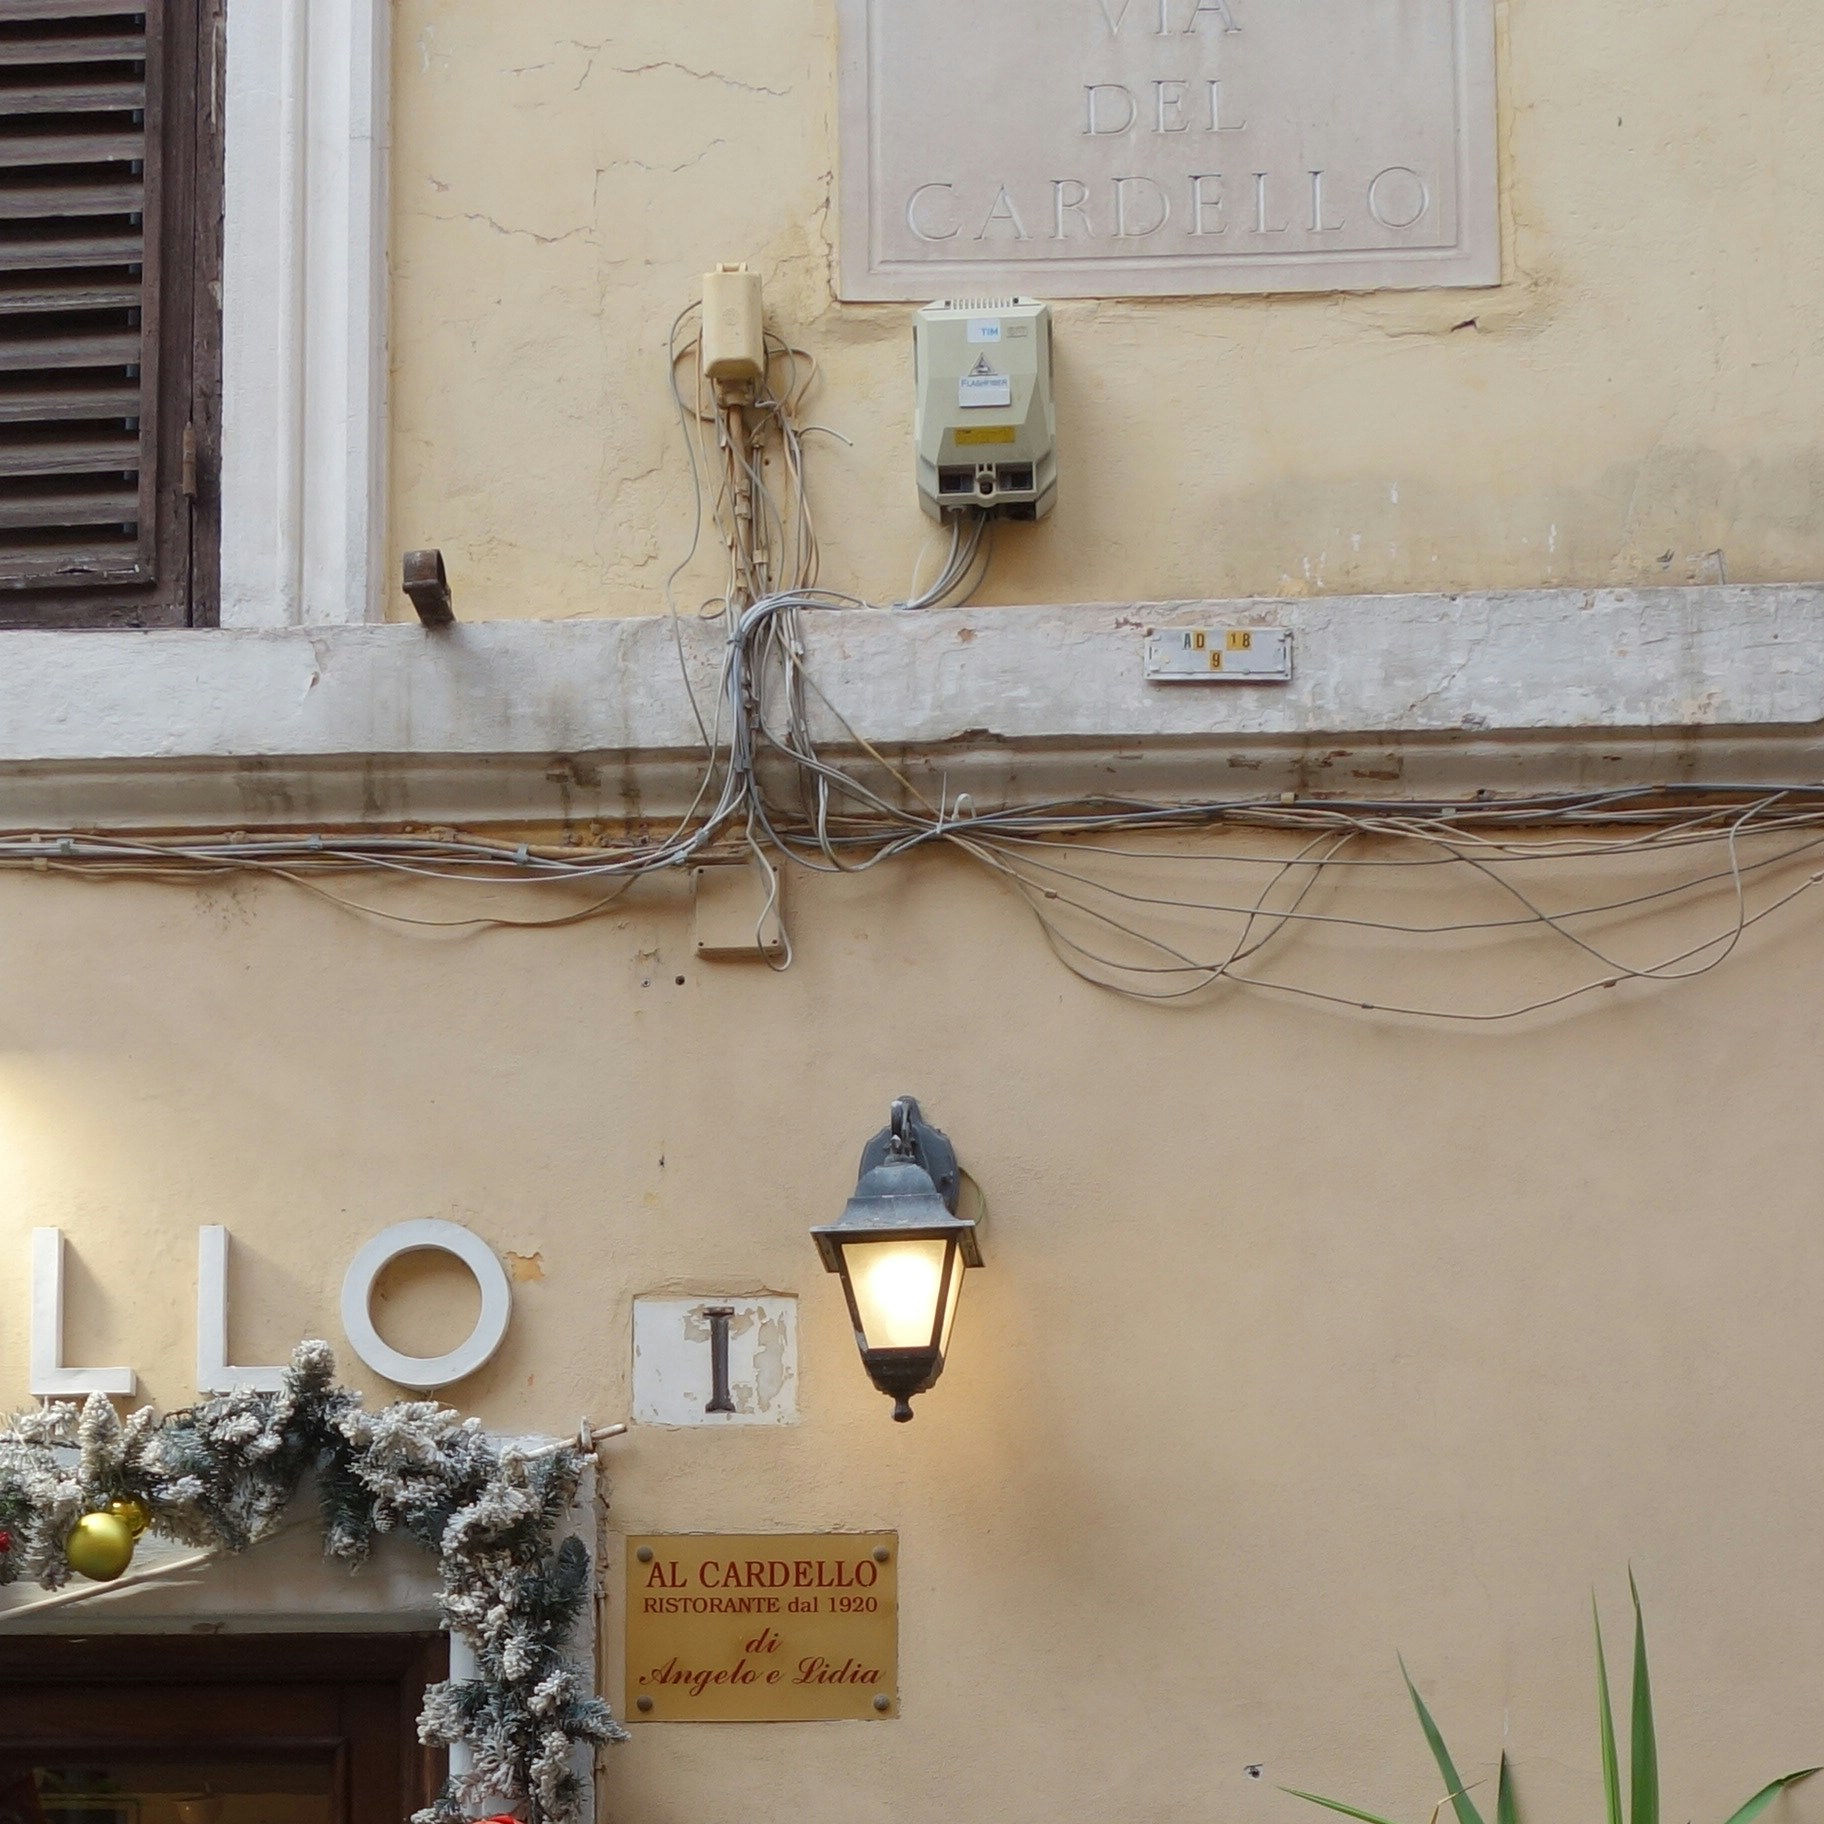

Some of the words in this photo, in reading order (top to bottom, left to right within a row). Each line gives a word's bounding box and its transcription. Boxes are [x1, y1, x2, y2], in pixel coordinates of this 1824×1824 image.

[1097, 0, 1242, 36] VIA
[1082, 80, 1246, 135] DEL
[906, 166, 1430, 242] CARDELLO
[980, 328, 999, 337] TIM
[1183, 632, 1206, 650] AD
[1230, 632, 1251, 649] 18
[1212, 652, 1221, 669] 9
[646, 1560, 688, 1588] AL
[699, 1559, 879, 1588] CARDELLO
[643, 1596, 781, 1614] RISTORANTE
[787, 1595, 819, 1614] dal
[828, 1596, 879, 1614] 1920
[744, 1627, 783, 1655] di
[639, 1656, 762, 1697] Angelo
[766, 1669, 784, 1685] e
[792, 1656, 887, 1687] Lidia
